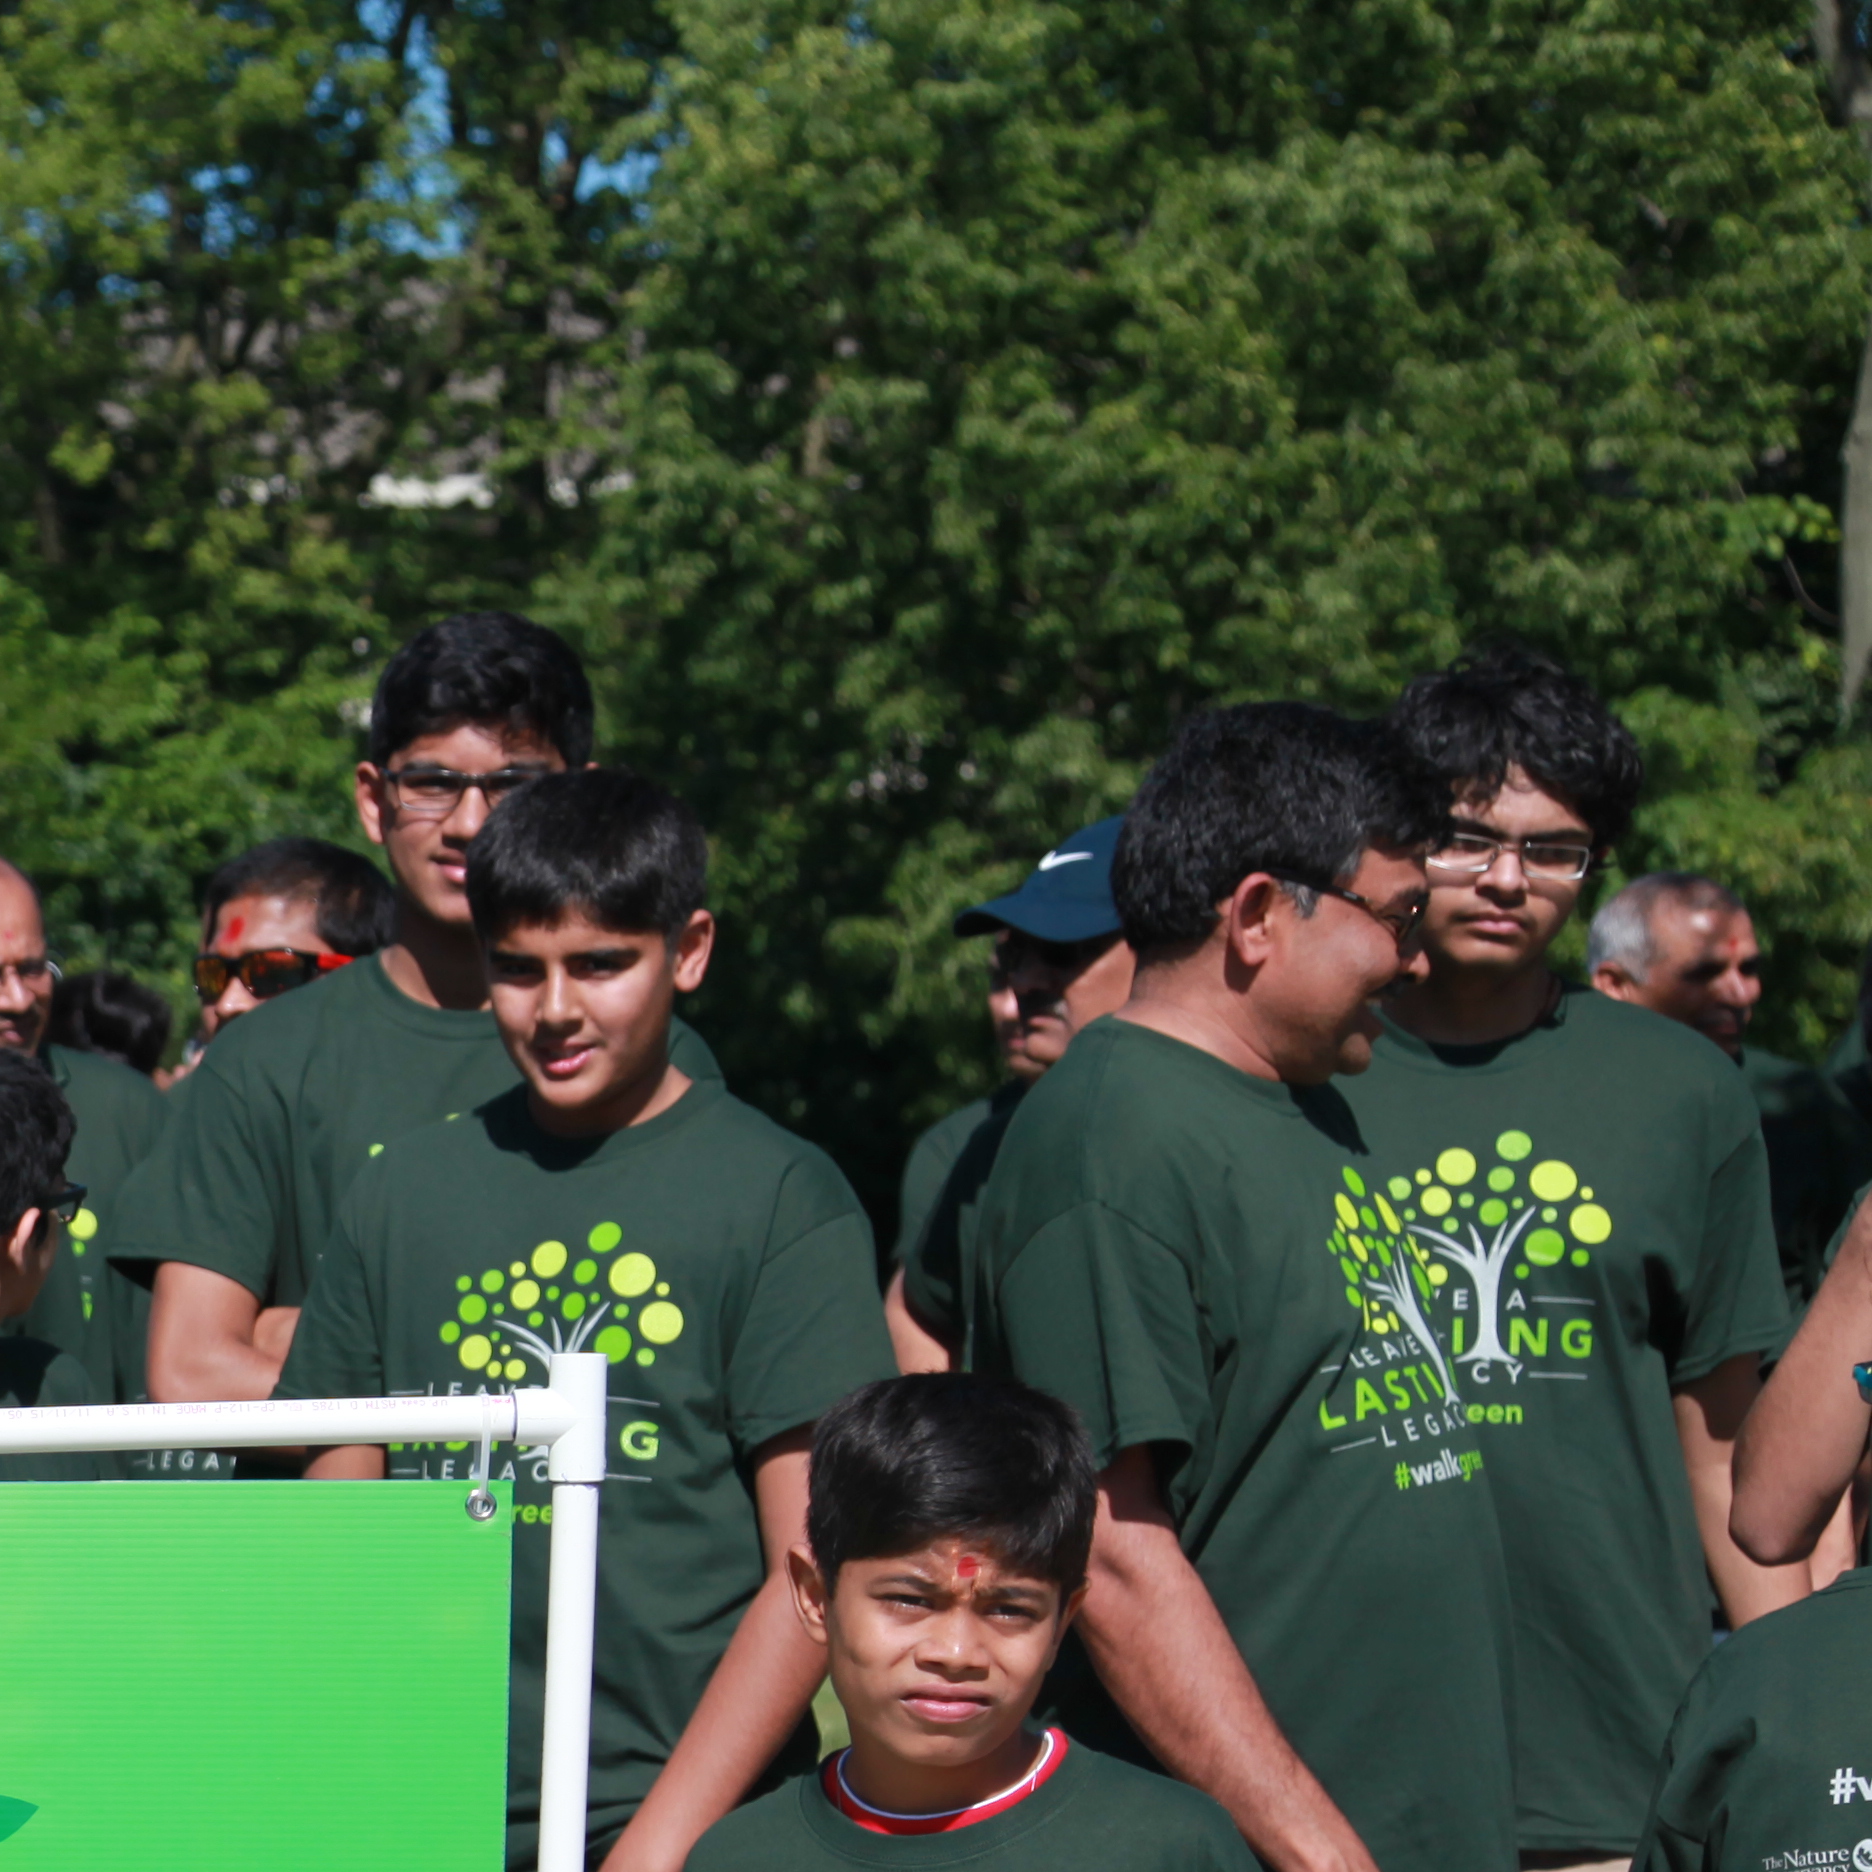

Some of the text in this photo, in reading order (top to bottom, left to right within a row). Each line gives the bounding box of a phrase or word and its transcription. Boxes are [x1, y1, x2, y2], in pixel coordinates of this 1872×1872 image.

[365, 1399, 396, 1409] ASTM
[1762, 1848, 1850, 1870] The Nature
